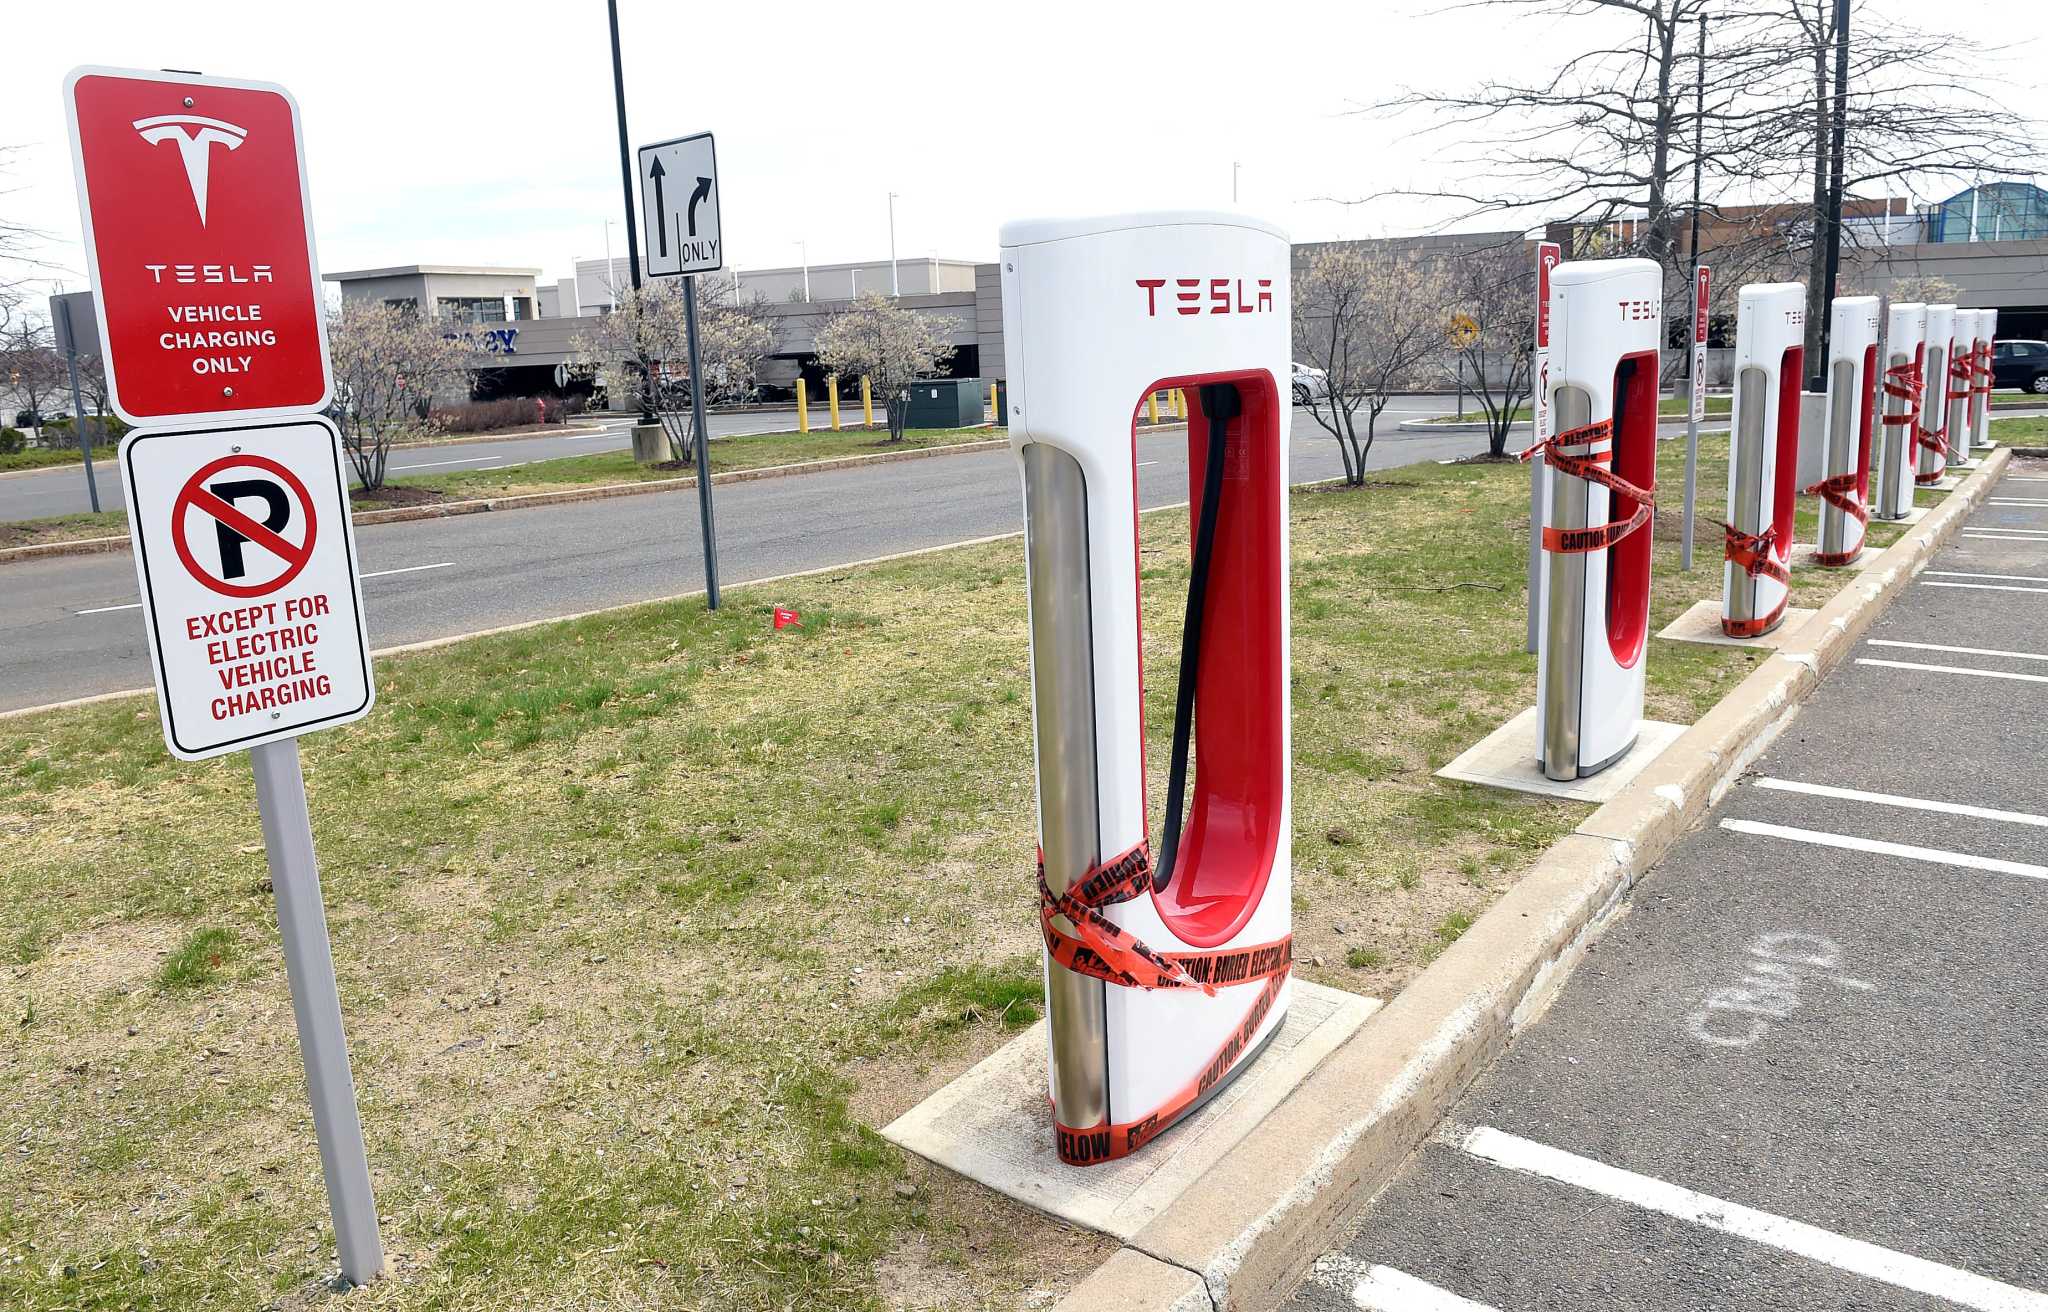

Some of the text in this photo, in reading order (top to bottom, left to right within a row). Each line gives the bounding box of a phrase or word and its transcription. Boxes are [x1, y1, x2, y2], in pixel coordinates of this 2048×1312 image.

[682, 239, 718, 263] ONLY
[145, 264, 274, 284] TESLA
[168, 304, 263, 323] VEHICLE
[1136, 278, 1273, 317] TESLA
[159, 329, 277, 351] CHARGING
[192, 355, 252, 375] ONLY
[185, 594, 330, 641] EXCEPT FOR
[206, 622, 319, 665] ELECTRIC
[218, 650, 317, 691] VEHICLE
[210, 674, 332, 721] CHARGING
[1213, 952, 1251, 984] BURIED
